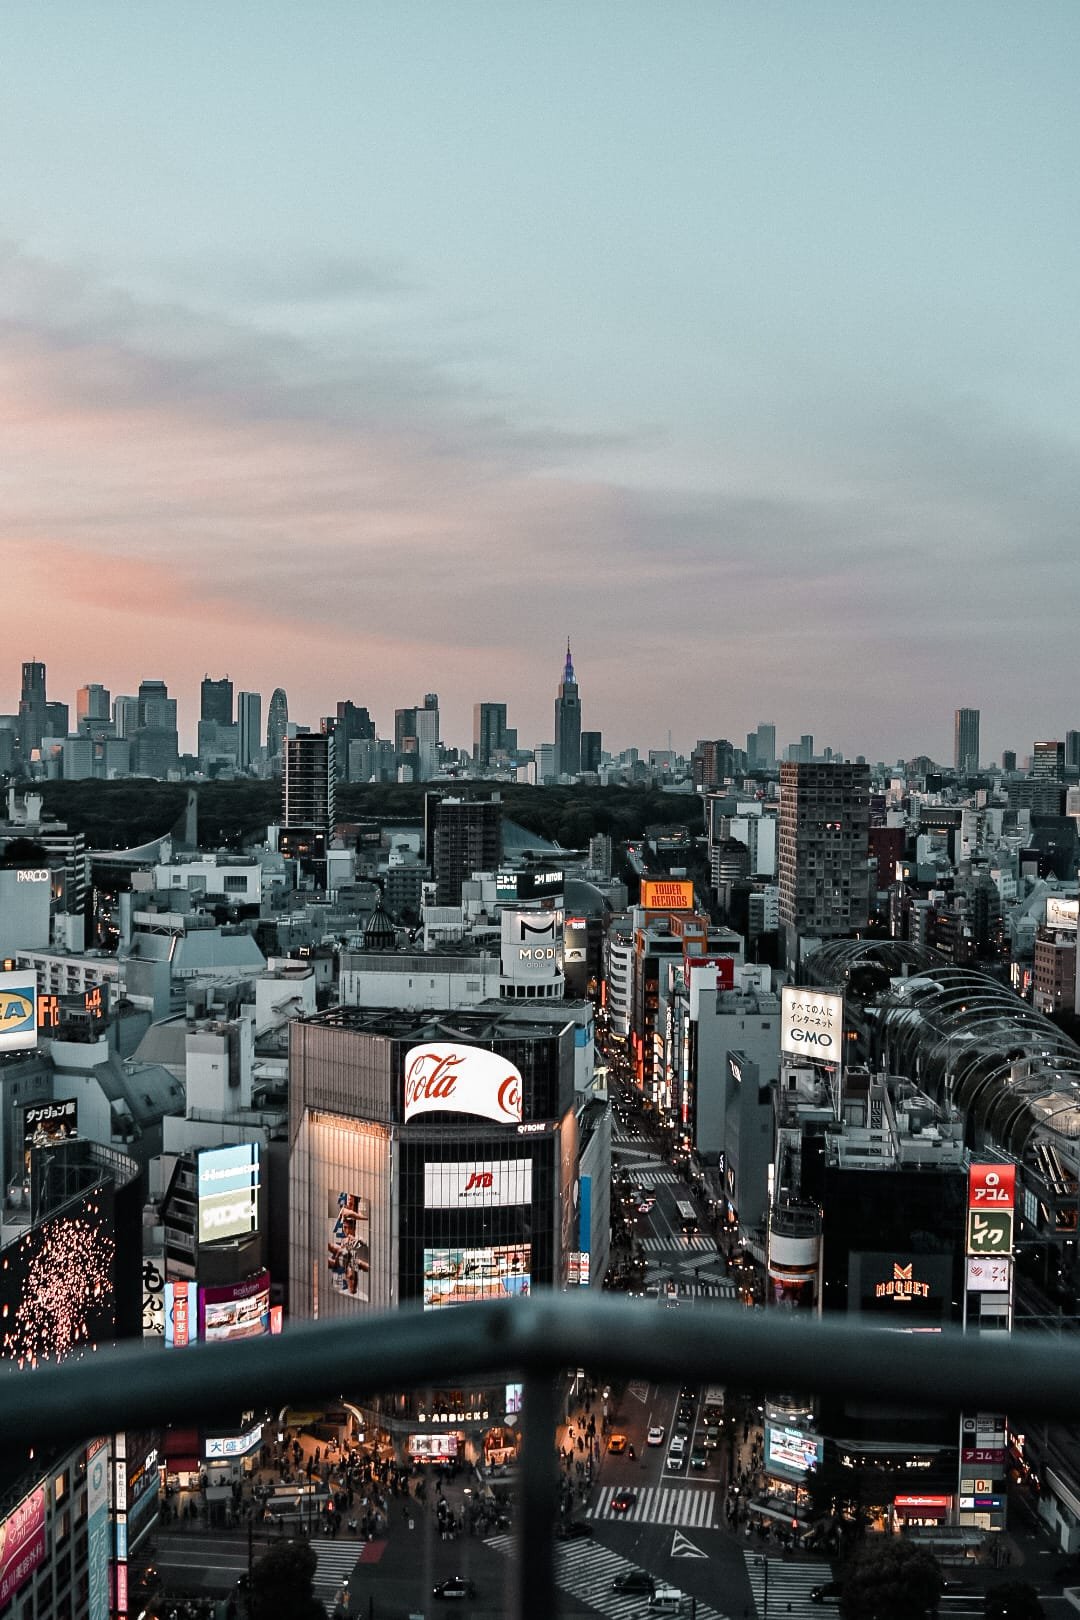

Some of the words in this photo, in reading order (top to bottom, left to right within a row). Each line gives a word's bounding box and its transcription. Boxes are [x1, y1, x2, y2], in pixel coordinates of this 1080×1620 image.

[16, 869, 49, 882] PARCO
[655, 883, 682, 895] TOWER
[651, 896, 688, 907] RECORDS
[519, 948, 556, 961] MODI
[791, 1002, 833, 1017] すべての人に
[790, 1013, 833, 1029] インターネット
[790, 1028, 833, 1047] GMO
[405, 1054, 467, 1108] Cola
[465, 1172, 494, 1191] JTB
[974, 1187, 1010, 1201] アコム
[418, 1411, 489, 1423] SARBUCKS
[966, 1451, 993, 1460] アコム
